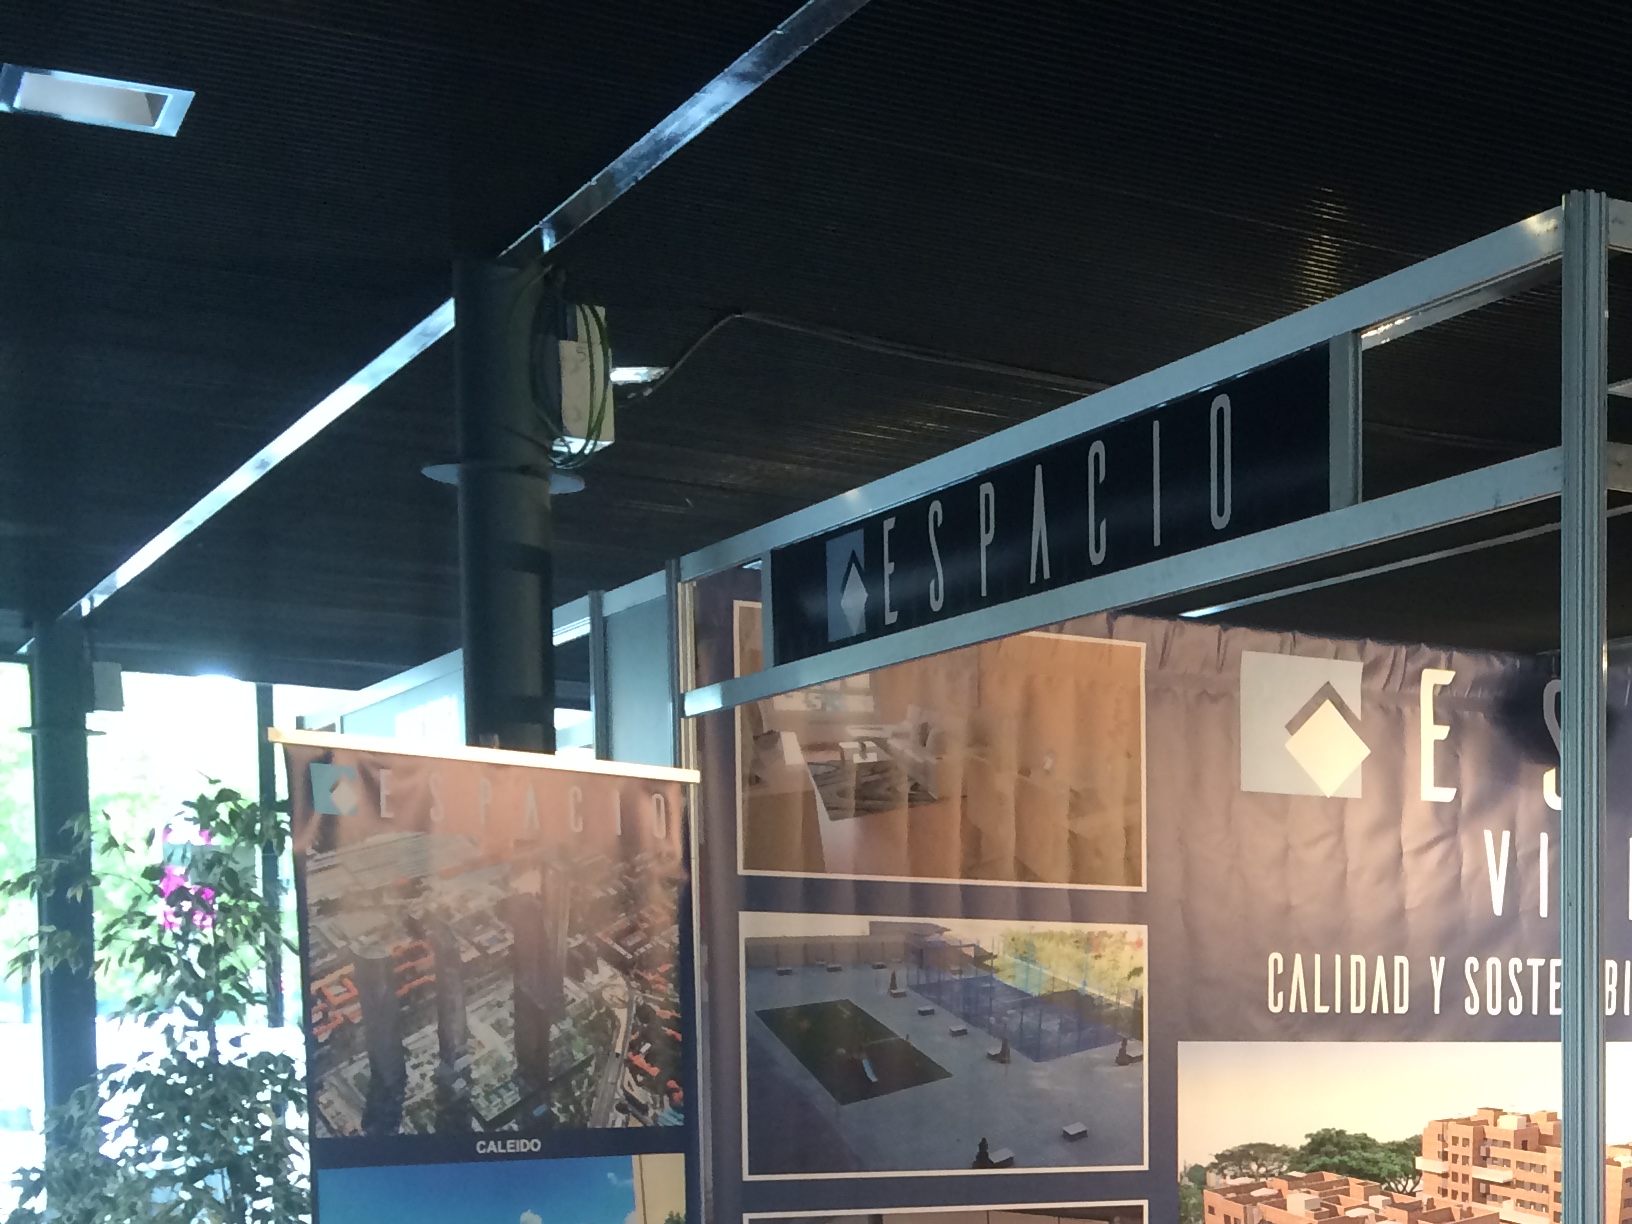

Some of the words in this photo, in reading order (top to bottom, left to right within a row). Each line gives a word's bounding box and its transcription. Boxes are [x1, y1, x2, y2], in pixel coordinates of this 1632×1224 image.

[882, 394, 1232, 625] ESPACIO
[379, 768, 668, 840] ESPACIO
[1267, 951, 1410, 1015] CALIDAD
[1429, 956, 1446, 1015] Y
[475, 1138, 542, 1154] CALEIDO
